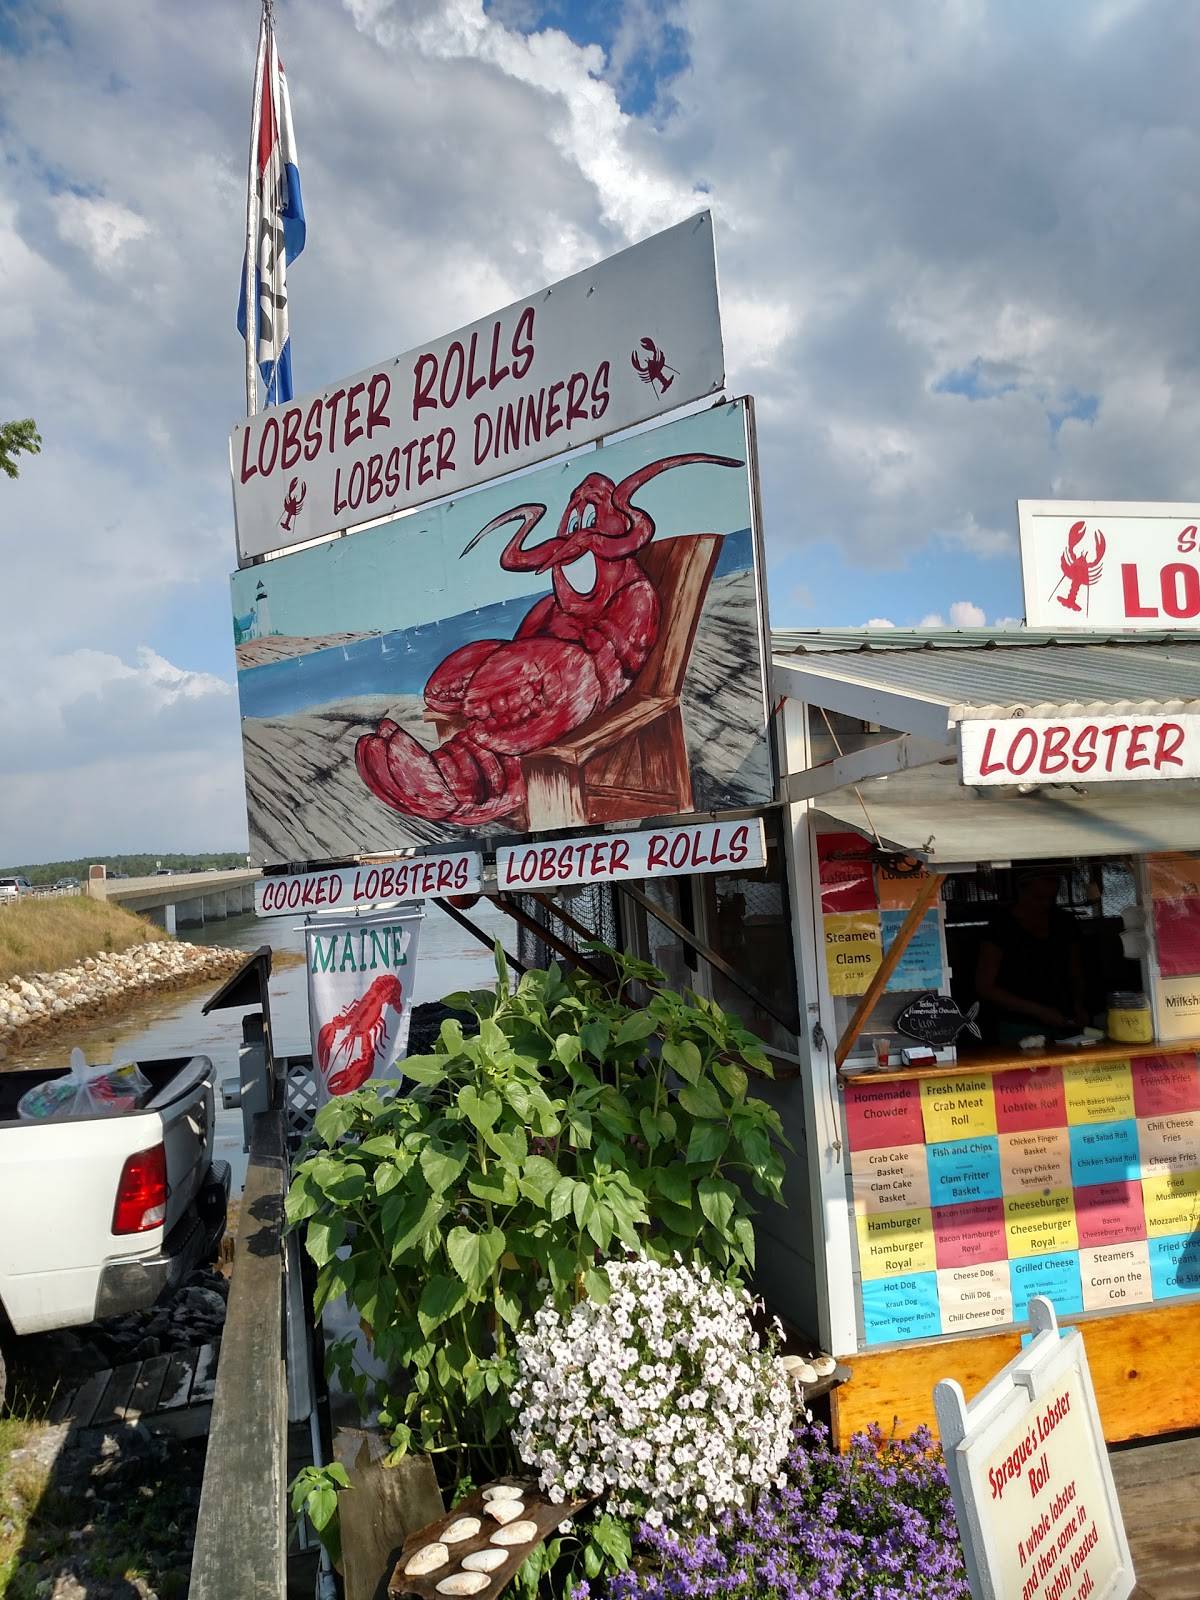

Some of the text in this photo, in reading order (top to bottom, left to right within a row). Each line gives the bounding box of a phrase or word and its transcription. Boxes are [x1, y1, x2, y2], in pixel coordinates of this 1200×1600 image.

[241, 307, 535, 484] LOBSTER ROLLS
[333, 361, 610, 516] LOBSTER DINNERS
[979, 723, 1185, 776] LOBSTER
[506, 825, 749, 885] LOBSTER ROLLS
[262, 857, 469, 911] COOKED LOBSTERS
[825, 930, 876, 944] Steamed
[312, 926, 408, 974] MAINE
[836, 953, 872, 965] Clams
[927, 1081, 987, 1096] Fresh Maine
[854, 1089, 912, 1103] Homemade
[934, 1097, 983, 1112] Crab Meat
[1003, 1102, 1037, 1113] Lobster
[1069, 1100, 1086, 1108] Fresh
[1087, 1098, 1105, 1106] Baked
[864, 1107, 908, 1119] Chowder
[1088, 1106, 1116, 1116] Sandwich
[951, 1116, 969, 1126] Roll
[1147, 1119, 1194, 1132] Chili Cheese
[1009, 1134, 1058, 1146] Chicken Finger
[1083, 1136, 1095, 1145] Egg
[1095, 1134, 1113, 1142] Salad
[1163, 1134, 1181, 1142] Fries
[932, 1143, 992, 1157] Fish and Chips
[1024, 1147, 1047, 1155] Basket
[869, 1152, 909, 1164] Crab Cake
[1078, 1154, 1137, 1167] Chicken Salad Roll
[1149, 1153, 1197, 1165] Cheese Fries
[877, 1167, 903, 1177] Basket
[1012, 1163, 1060, 1176] Crispy Chicken
[940, 1171, 989, 1184] Clam Fritter
[1020, 1175, 1053, 1185] Sandwich
[1167, 1178, 1184, 1187] Fried
[871, 1179, 912, 1191] Clam Cake
[952, 1186, 981, 1197] Basket
[879, 1194, 906, 1204] Basket
[1156, 1191, 1198, 1201] Mushrooms
[1008, 1196, 1069, 1212] Cheeseburger
[868, 1216, 921, 1232] Hamburger
[1010, 1218, 1072, 1235] Cheeseburger
[1149, 1214, 1187, 1226] Mozzarella
[938, 1229, 1001, 1243] Bacon Hamburger
[1082, 1224, 1142, 1239] Cheeseburger Royal
[870, 1239, 924, 1256] Hamburger
[961, 1243, 981, 1254] Royal
[1031, 1236, 1056, 1249] Royal
[1158, 1240, 1180, 1253] Fried
[1093, 1250, 1135, 1263] Steamers
[1172, 1254, 1198, 1265] Beans
[885, 1257, 912, 1271] Royal
[1015, 1258, 1074, 1274] Grilled Cheese
[953, 1269, 994, 1280] Cheese Dog
[1091, 1276, 1112, 1287] Corn
[1127, 1271, 1142, 1281] the
[1166, 1273, 1184, 1286] Cole
[884, 1282, 899, 1291] Hot
[900, 1280, 917, 1290] Dog
[960, 1291, 976, 1300] Chili
[977, 1290, 991, 1299] Dog
[1109, 1288, 1126, 1299] Cob
[886, 1300, 904, 1308] Kraut
[904, 1298, 918, 1307] Dog
[870, 1312, 936, 1327] Sweet Pepper Relish
[948, 1307, 1005, 1322] Chili Cheese Dog
[897, 1325, 911, 1334] Dog
[988, 1391, 1071, 1501] Sprague's Lobster
[1028, 1452, 1050, 1498] Roll
[1017, 1480, 1077, 1569] A whole lobster
[1022, 1505, 1087, 1600] and then some in
[1044, 1520, 1098, 1600] lightly toasted
